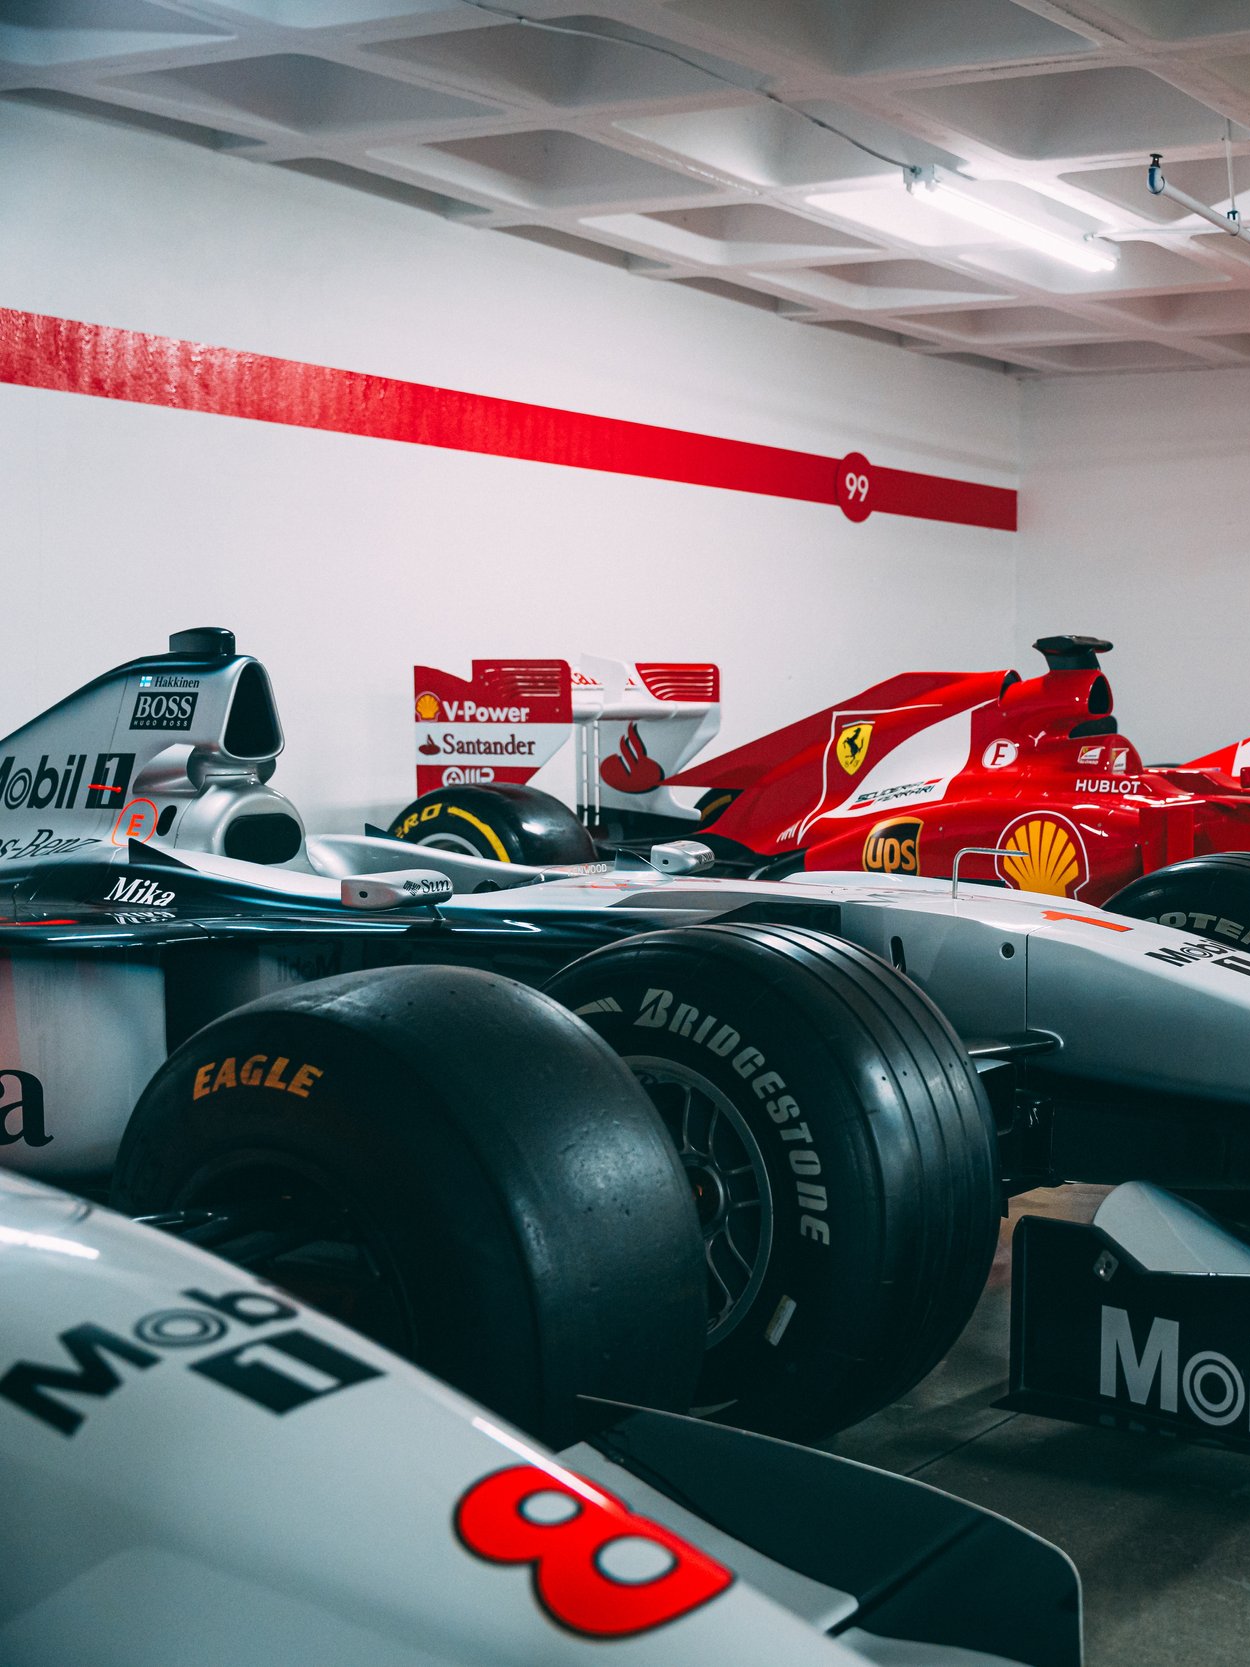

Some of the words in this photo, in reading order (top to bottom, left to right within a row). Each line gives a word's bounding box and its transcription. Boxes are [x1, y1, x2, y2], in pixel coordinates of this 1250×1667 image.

[845, 472, 869, 502] 99
[154, 676, 200, 689] Hakkinen
[135, 695, 193, 718] BOSS
[442, 700, 530, 722] V-Power
[442, 733, 536, 755] Santander
[1075, 779, 1141, 794] HUBLOT
[126, 813, 145, 836] E
[866, 837, 916, 872] ups
[103, 876, 176, 907] Mika
[421, 878, 450, 894] Sun
[193, 1054, 324, 1100] EAGLE
[633, 988, 830, 1246] BRIDGESTONE
